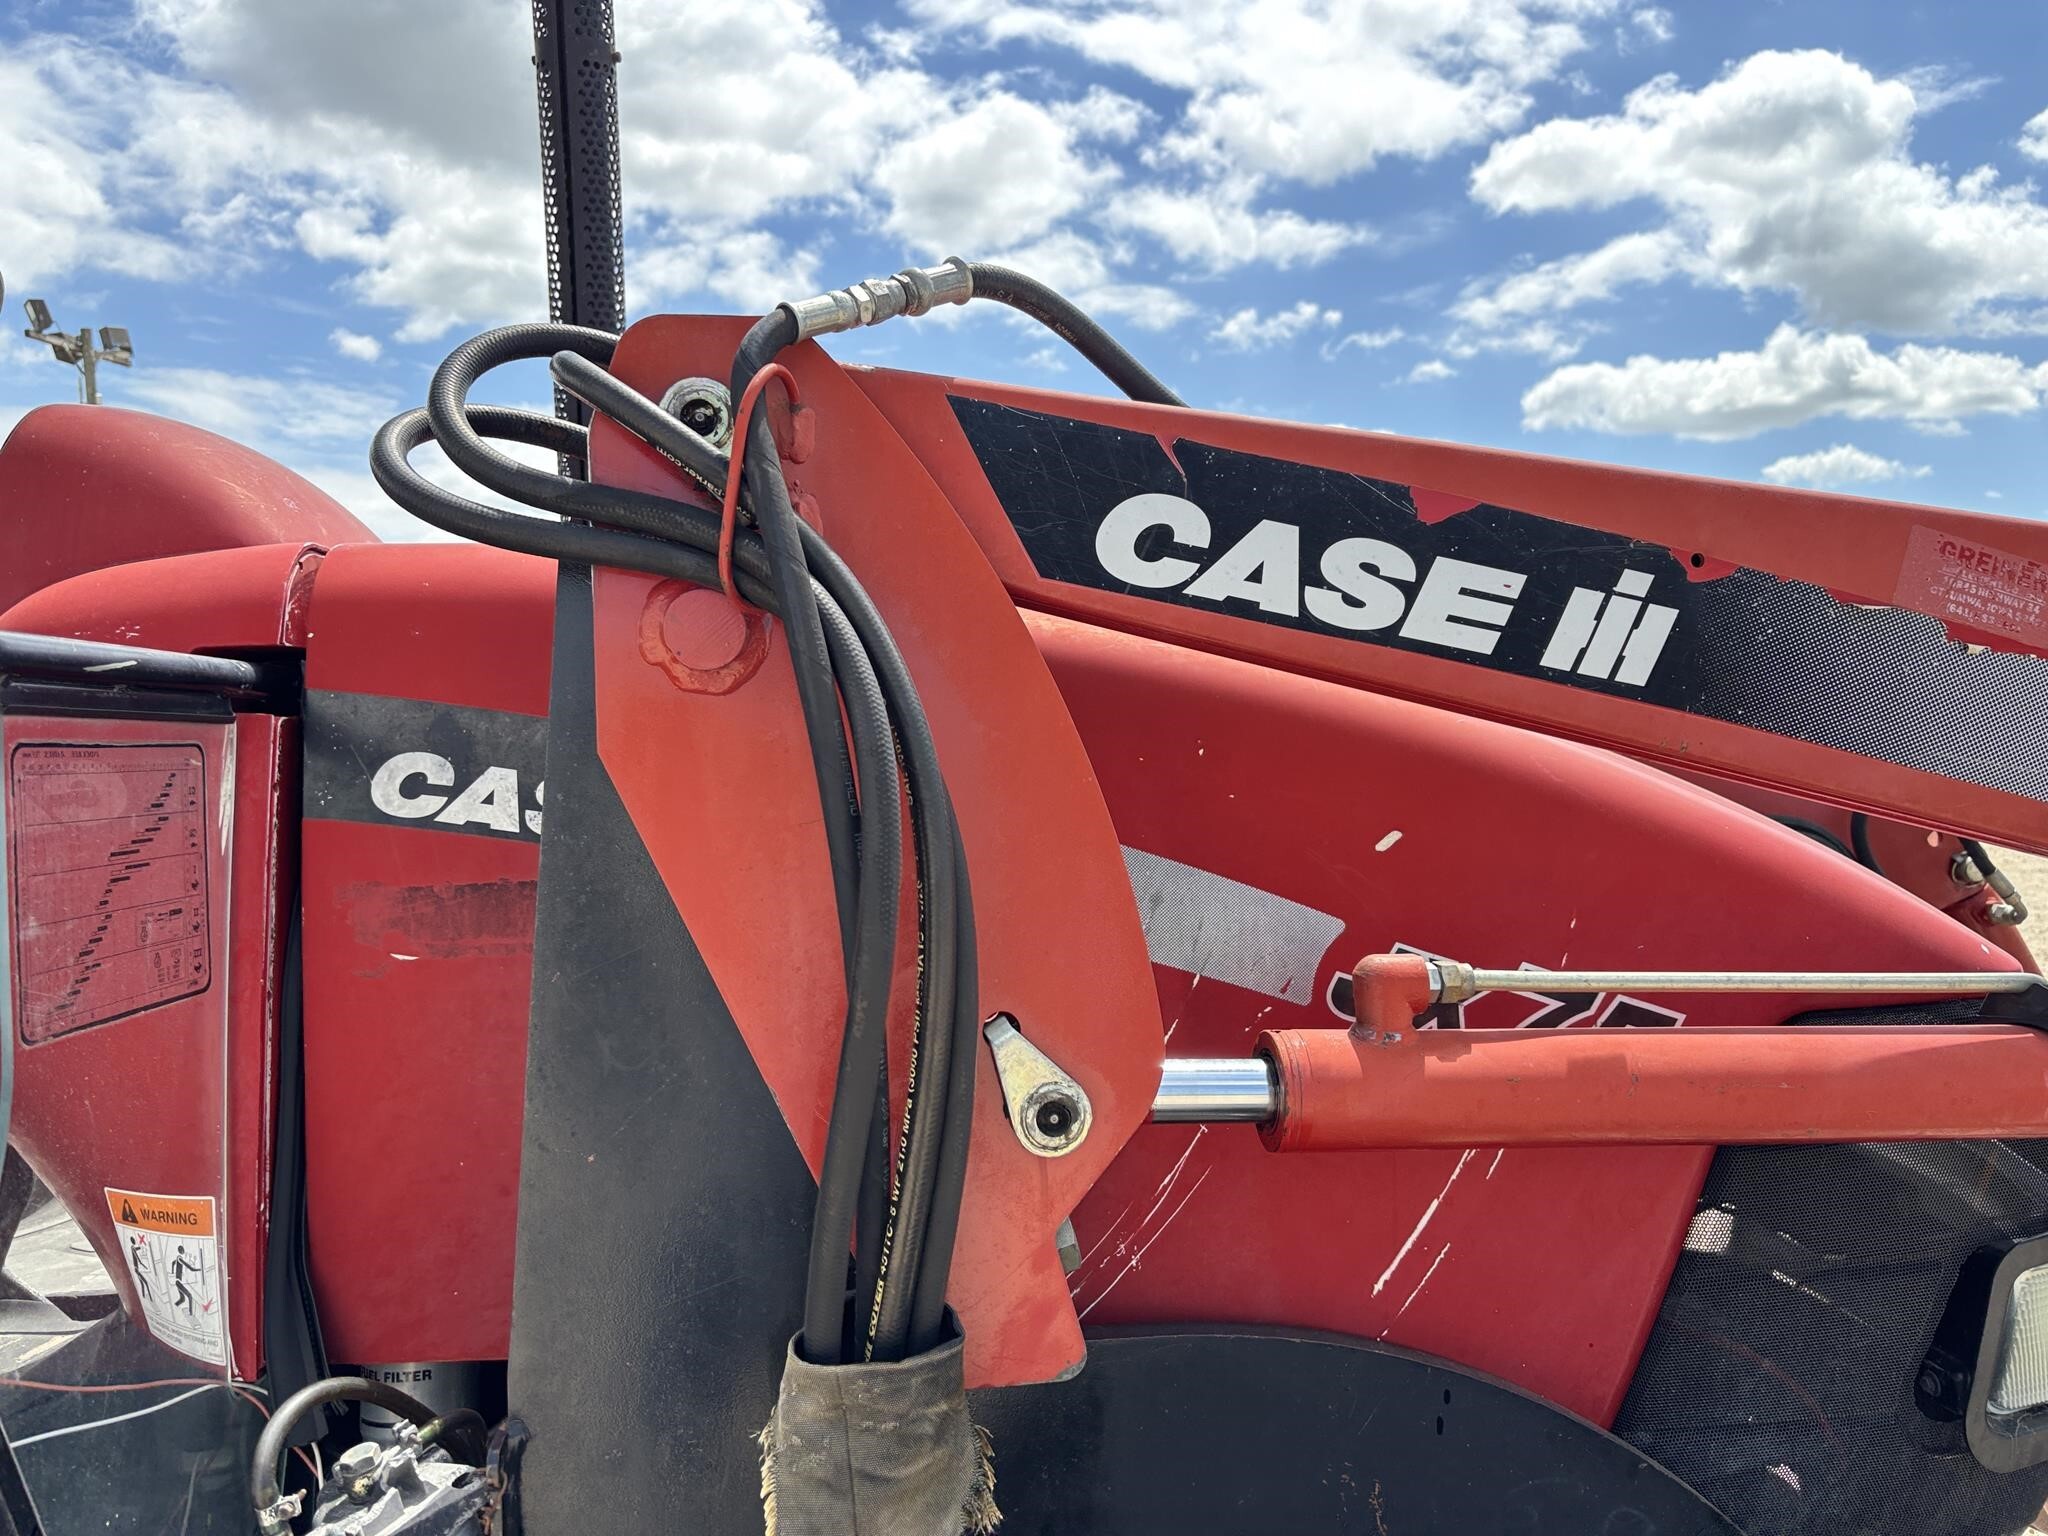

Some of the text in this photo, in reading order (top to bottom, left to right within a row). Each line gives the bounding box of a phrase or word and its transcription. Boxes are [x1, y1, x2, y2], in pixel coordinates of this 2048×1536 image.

[1095, 493, 1528, 655] CASE
[140, 1208, 198, 1226] WARNING
[868, 1278, 885, 1339] COVER
[384, 1368, 433, 1383] FILTER
